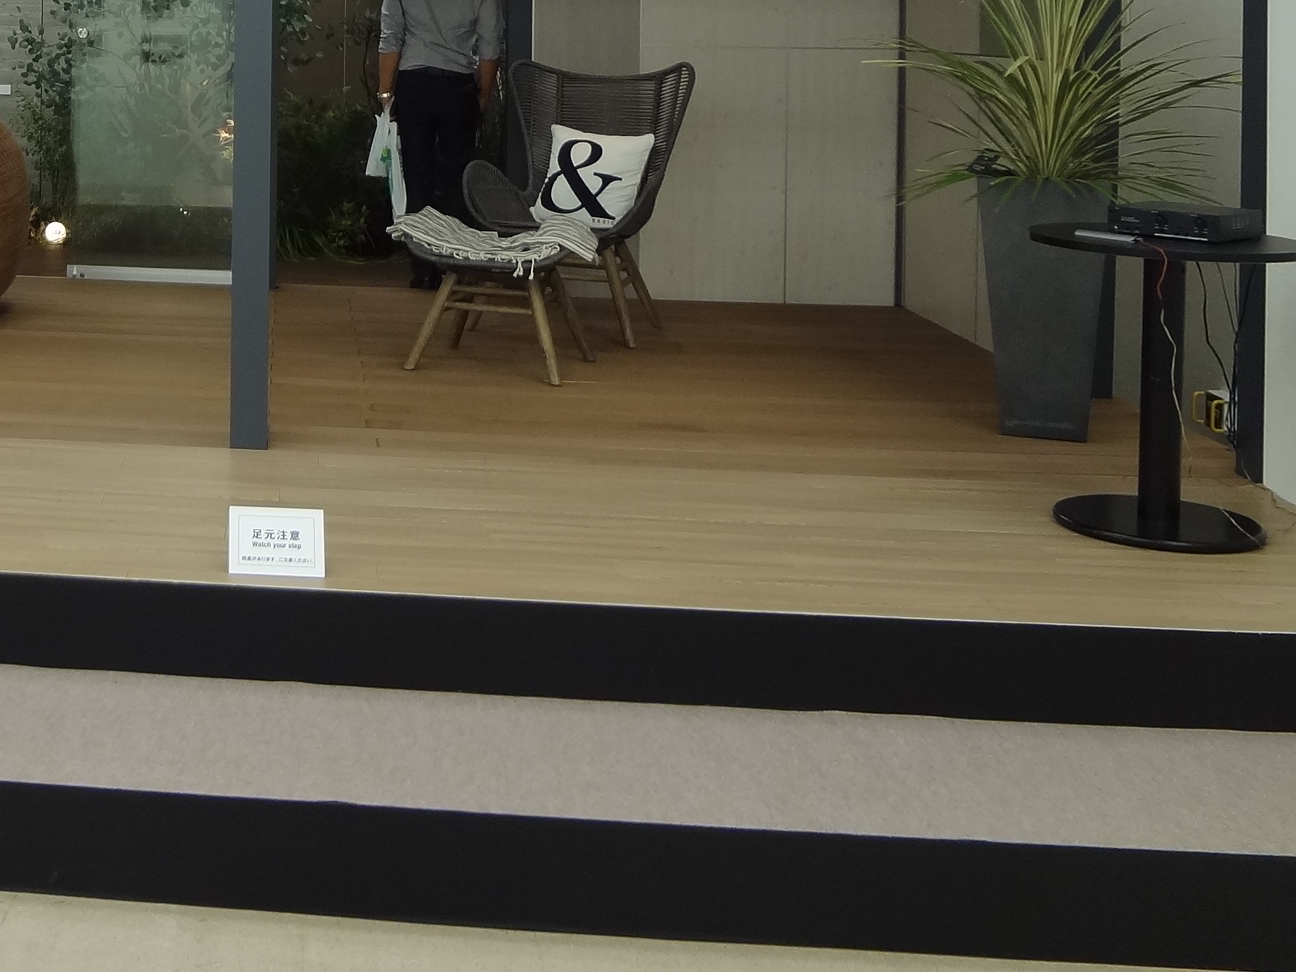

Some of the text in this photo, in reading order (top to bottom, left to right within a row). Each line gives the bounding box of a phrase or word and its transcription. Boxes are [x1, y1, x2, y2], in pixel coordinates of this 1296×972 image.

[540, 139, 623, 220] &
[252, 528, 301, 541] 足元注意
[252, 540, 271, 548] Watch
[288, 542, 302, 550] step
